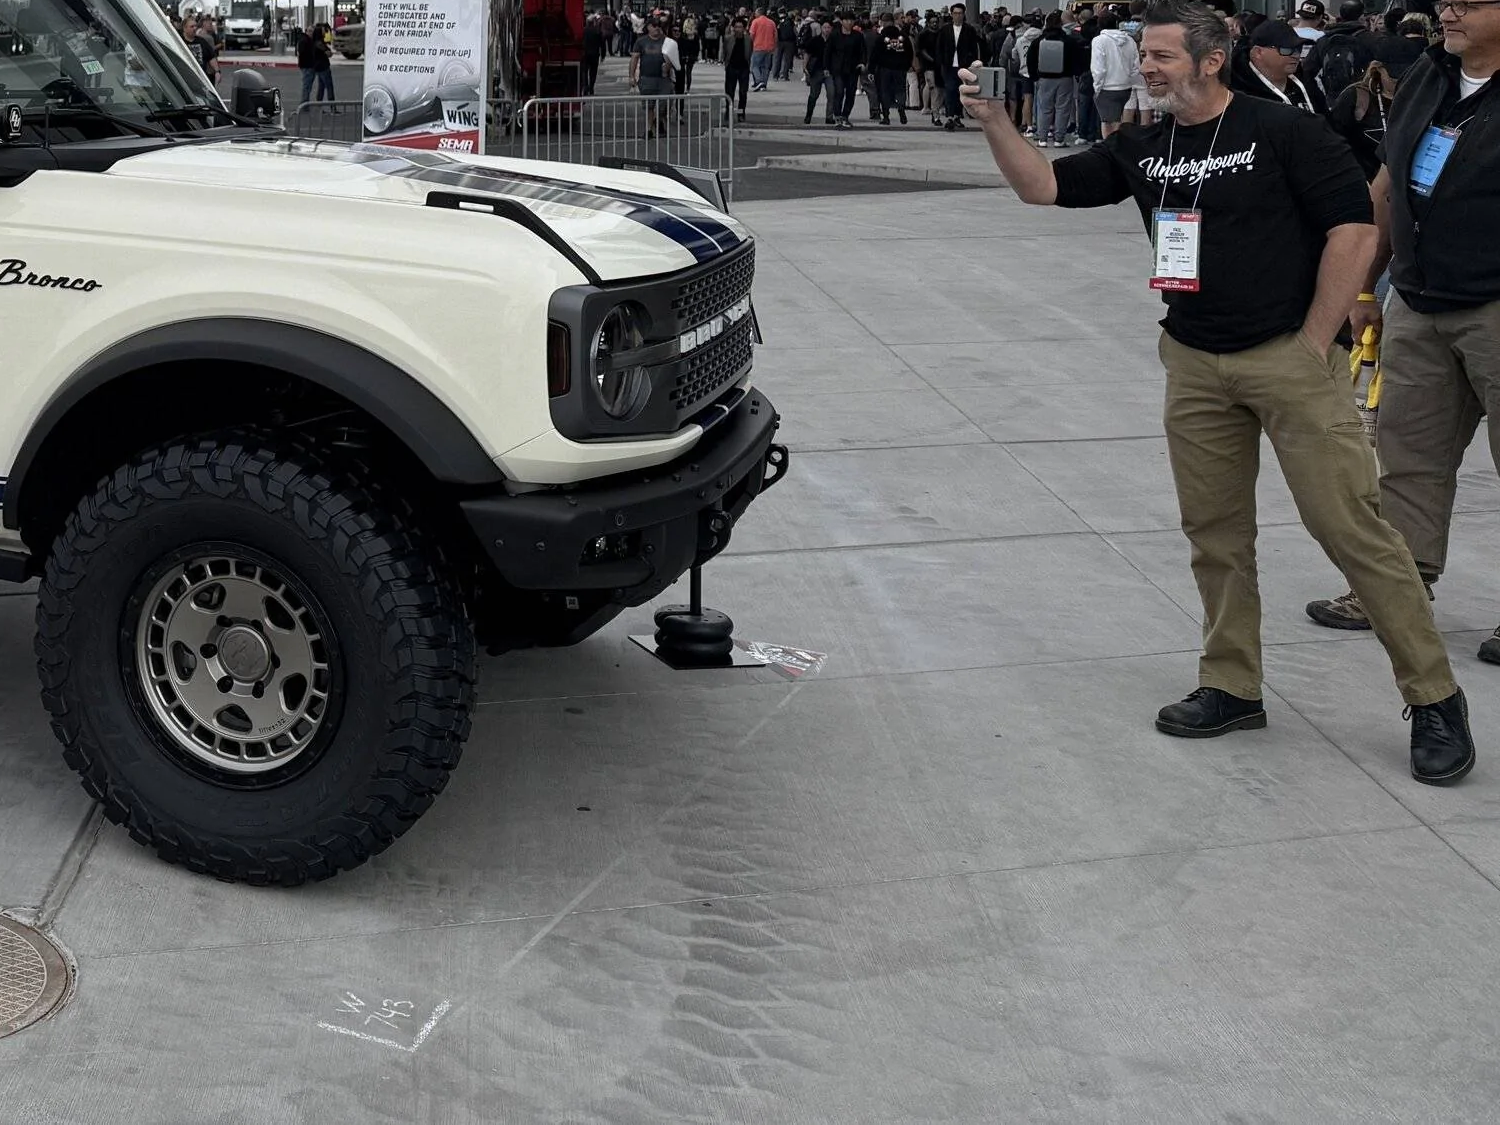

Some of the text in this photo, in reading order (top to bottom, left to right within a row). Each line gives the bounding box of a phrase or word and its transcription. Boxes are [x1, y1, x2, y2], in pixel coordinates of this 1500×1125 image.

[379, 3, 429, 11] THEY WILL BE
[378, 12, 428, 20] CONFISCATED
[377, 21, 456, 30] RETURNED AT END OF
[377, 29, 393, 37] DAY
[406, 30, 433, 38] FRIDAY
[389, 47, 426, 56] REQUIRED
[428, 48, 437, 56] TO
[377, 64, 435, 74] NO EXCEPTIONS
[446, 109, 479, 127] WING
[438, 137, 474, 151] SEMA
[1138, 142, 1257, 185] Underground
